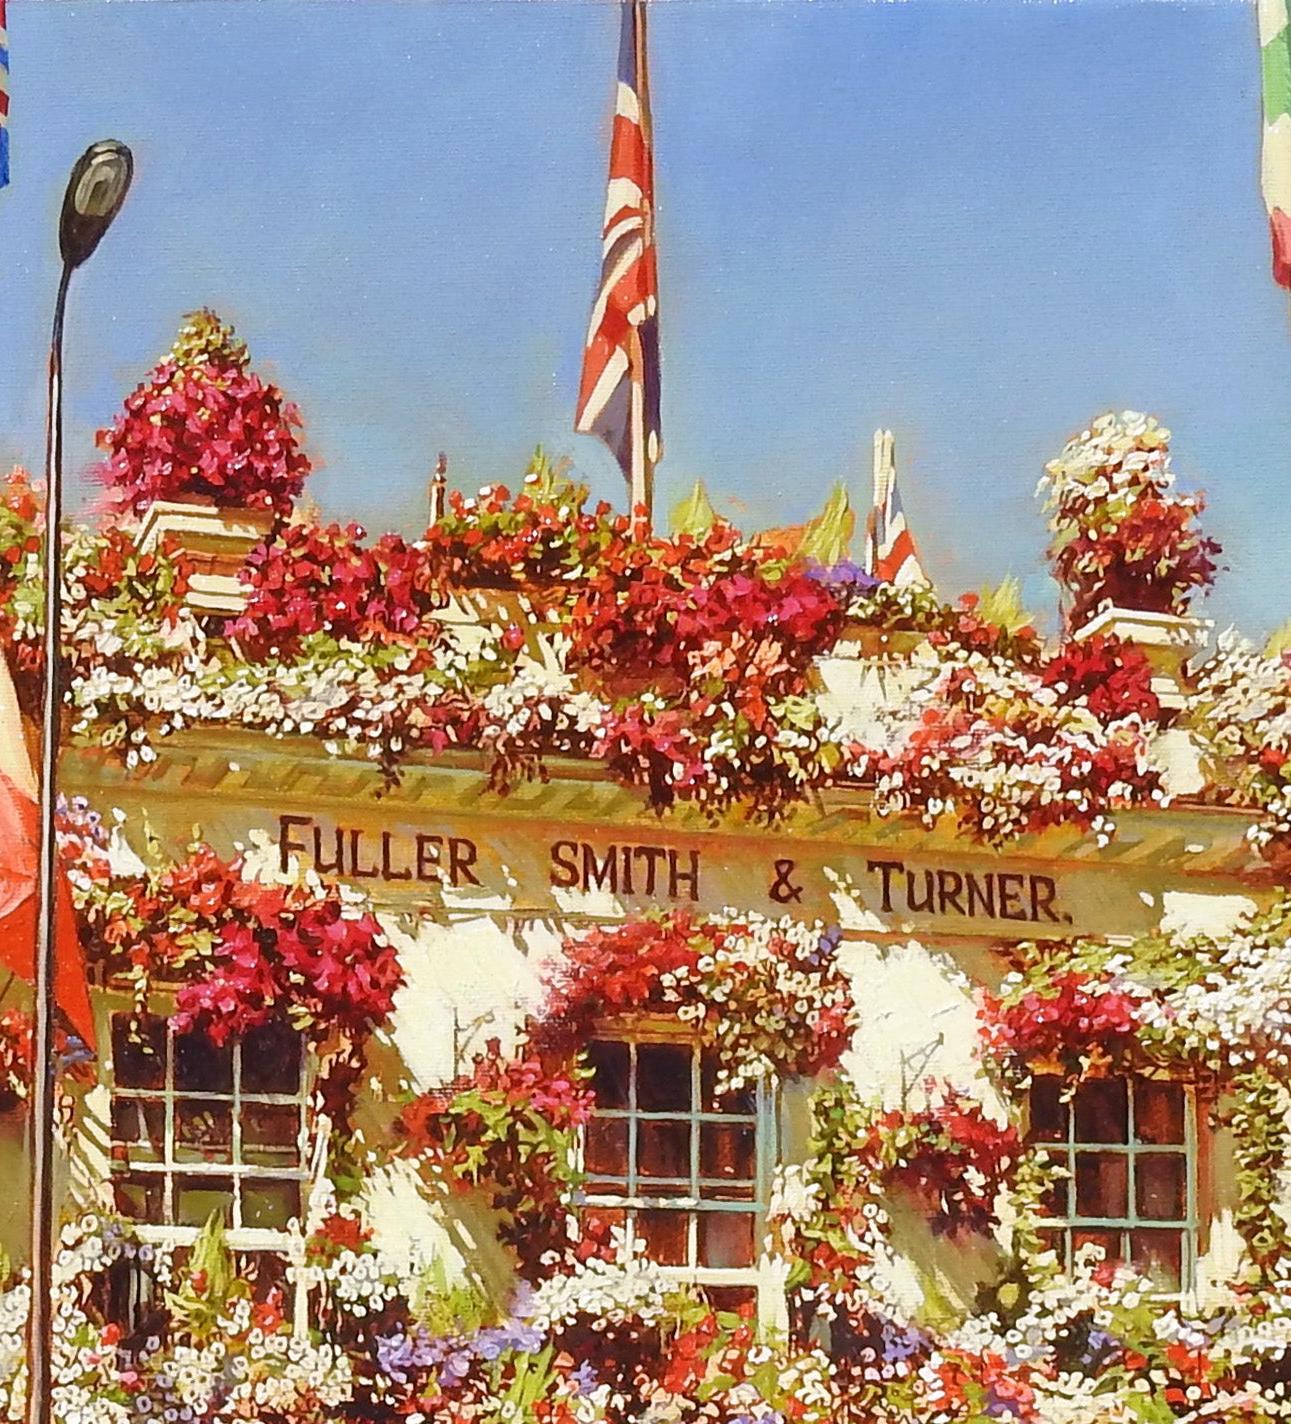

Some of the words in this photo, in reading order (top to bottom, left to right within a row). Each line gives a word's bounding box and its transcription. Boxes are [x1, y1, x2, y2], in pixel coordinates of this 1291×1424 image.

[278, 815, 480, 886] FULLER
[550, 838, 699, 902] SMITH
[769, 858, 803, 904] &
